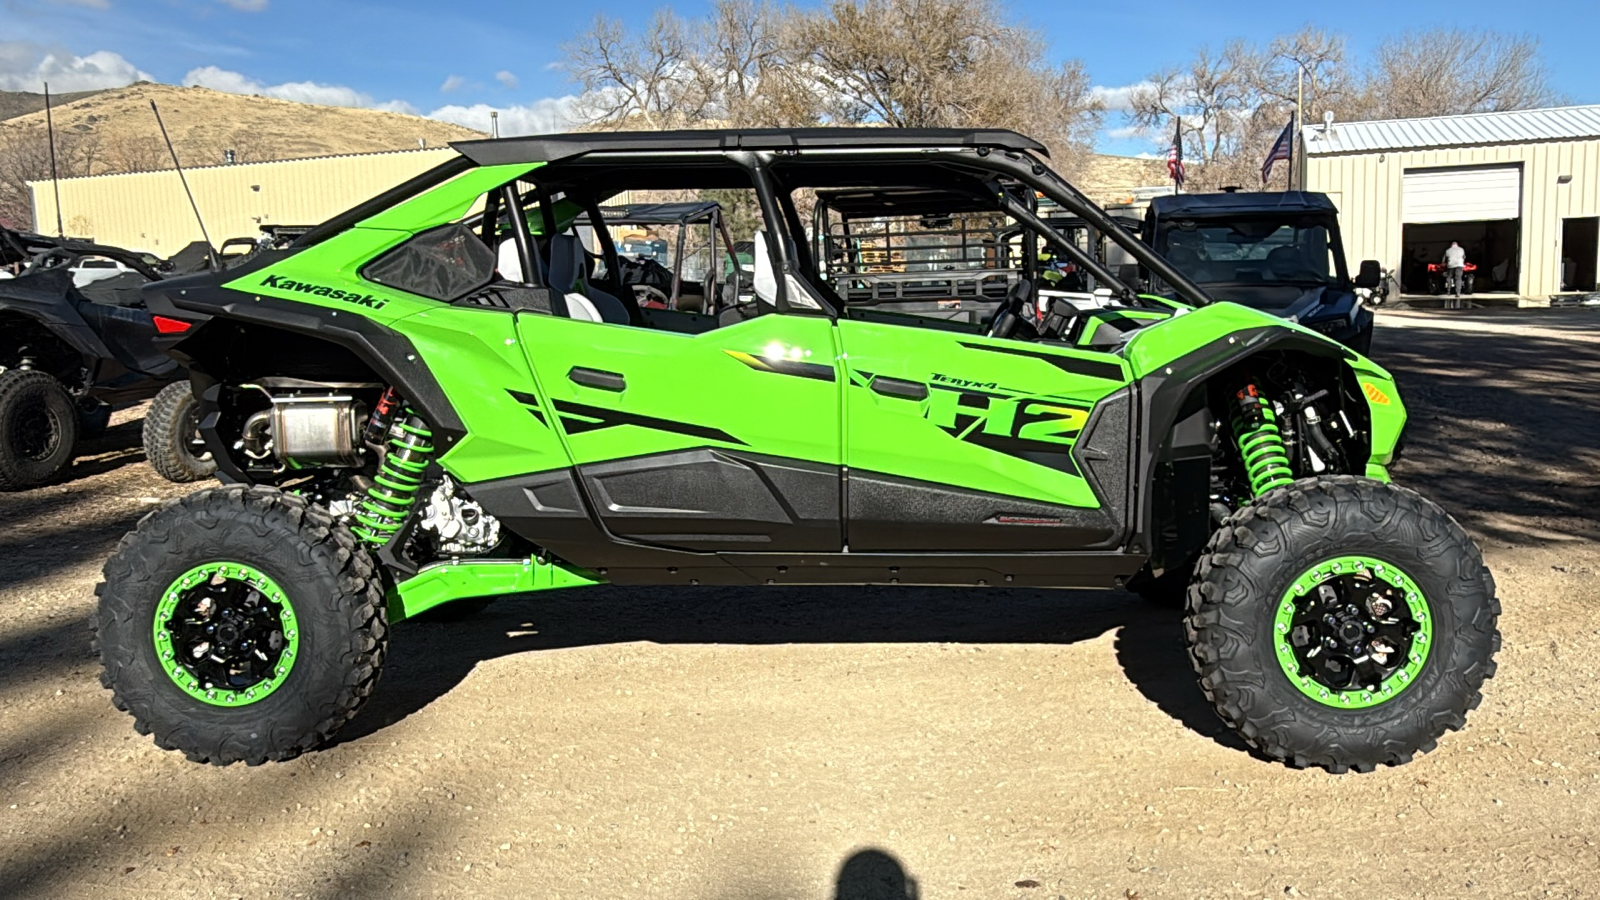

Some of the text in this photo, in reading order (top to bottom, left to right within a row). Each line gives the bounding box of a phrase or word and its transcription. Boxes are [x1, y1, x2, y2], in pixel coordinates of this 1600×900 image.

[261, 274, 390, 310] Kawasaki
[926, 388, 1090, 446] H2
[1265, 547, 1324, 606] CARNIVORE
